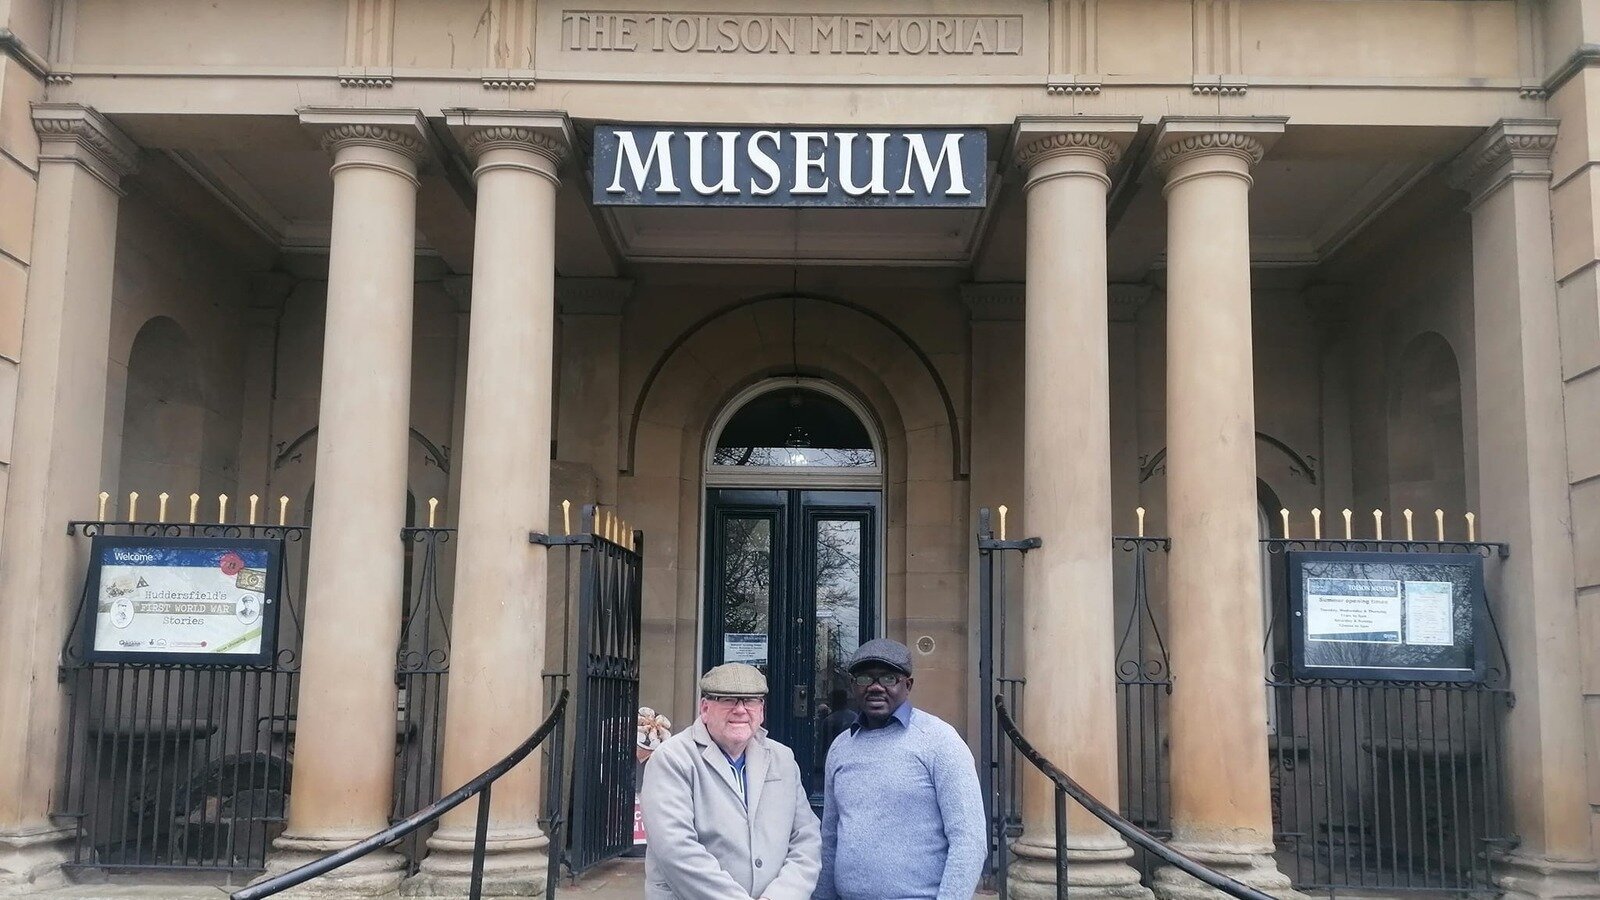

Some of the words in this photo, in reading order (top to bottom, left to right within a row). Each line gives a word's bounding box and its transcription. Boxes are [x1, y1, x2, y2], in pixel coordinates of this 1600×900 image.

[563, 12, 638, 51] THE
[646, 12, 797, 54] TOLSON
[809, 14, 1022, 55] MEMORIAL
[605, 129, 971, 197] MUSEUM
[114, 552, 153, 562] Welcome
[145, 591, 227, 600] Huddersfield's
[140, 603, 171, 612] FIRST
[174, 604, 206, 613] WORLD
[210, 605, 230, 613] WAR
[163, 616, 205, 625] Stories
